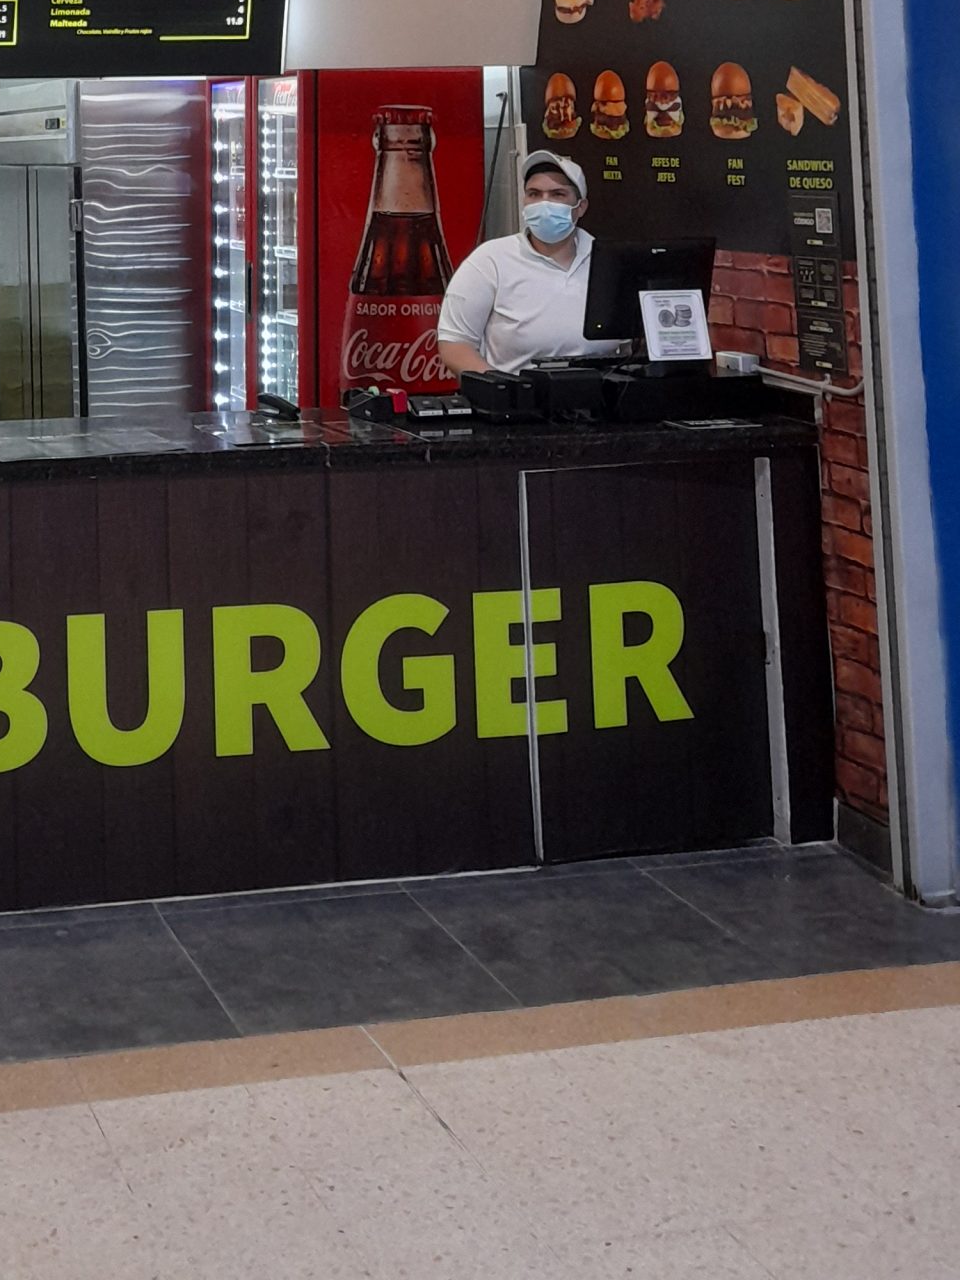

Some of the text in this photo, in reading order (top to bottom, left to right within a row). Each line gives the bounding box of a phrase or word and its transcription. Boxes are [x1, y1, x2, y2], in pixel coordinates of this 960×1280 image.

[50, 8, 91, 16] Limonada
[49, 19, 88, 28] Malteada
[605, 156, 618, 166] FAN
[651, 157, 680, 168] JEFES DE
[727, 158, 744, 170] FAN
[786, 160, 834, 172] SANDWICH
[656, 172, 676, 182] JEFES
[727, 174, 746, 186] FEST
[789, 177, 833, 189] DE QUESO
[356, 302, 397, 317] SABOR
